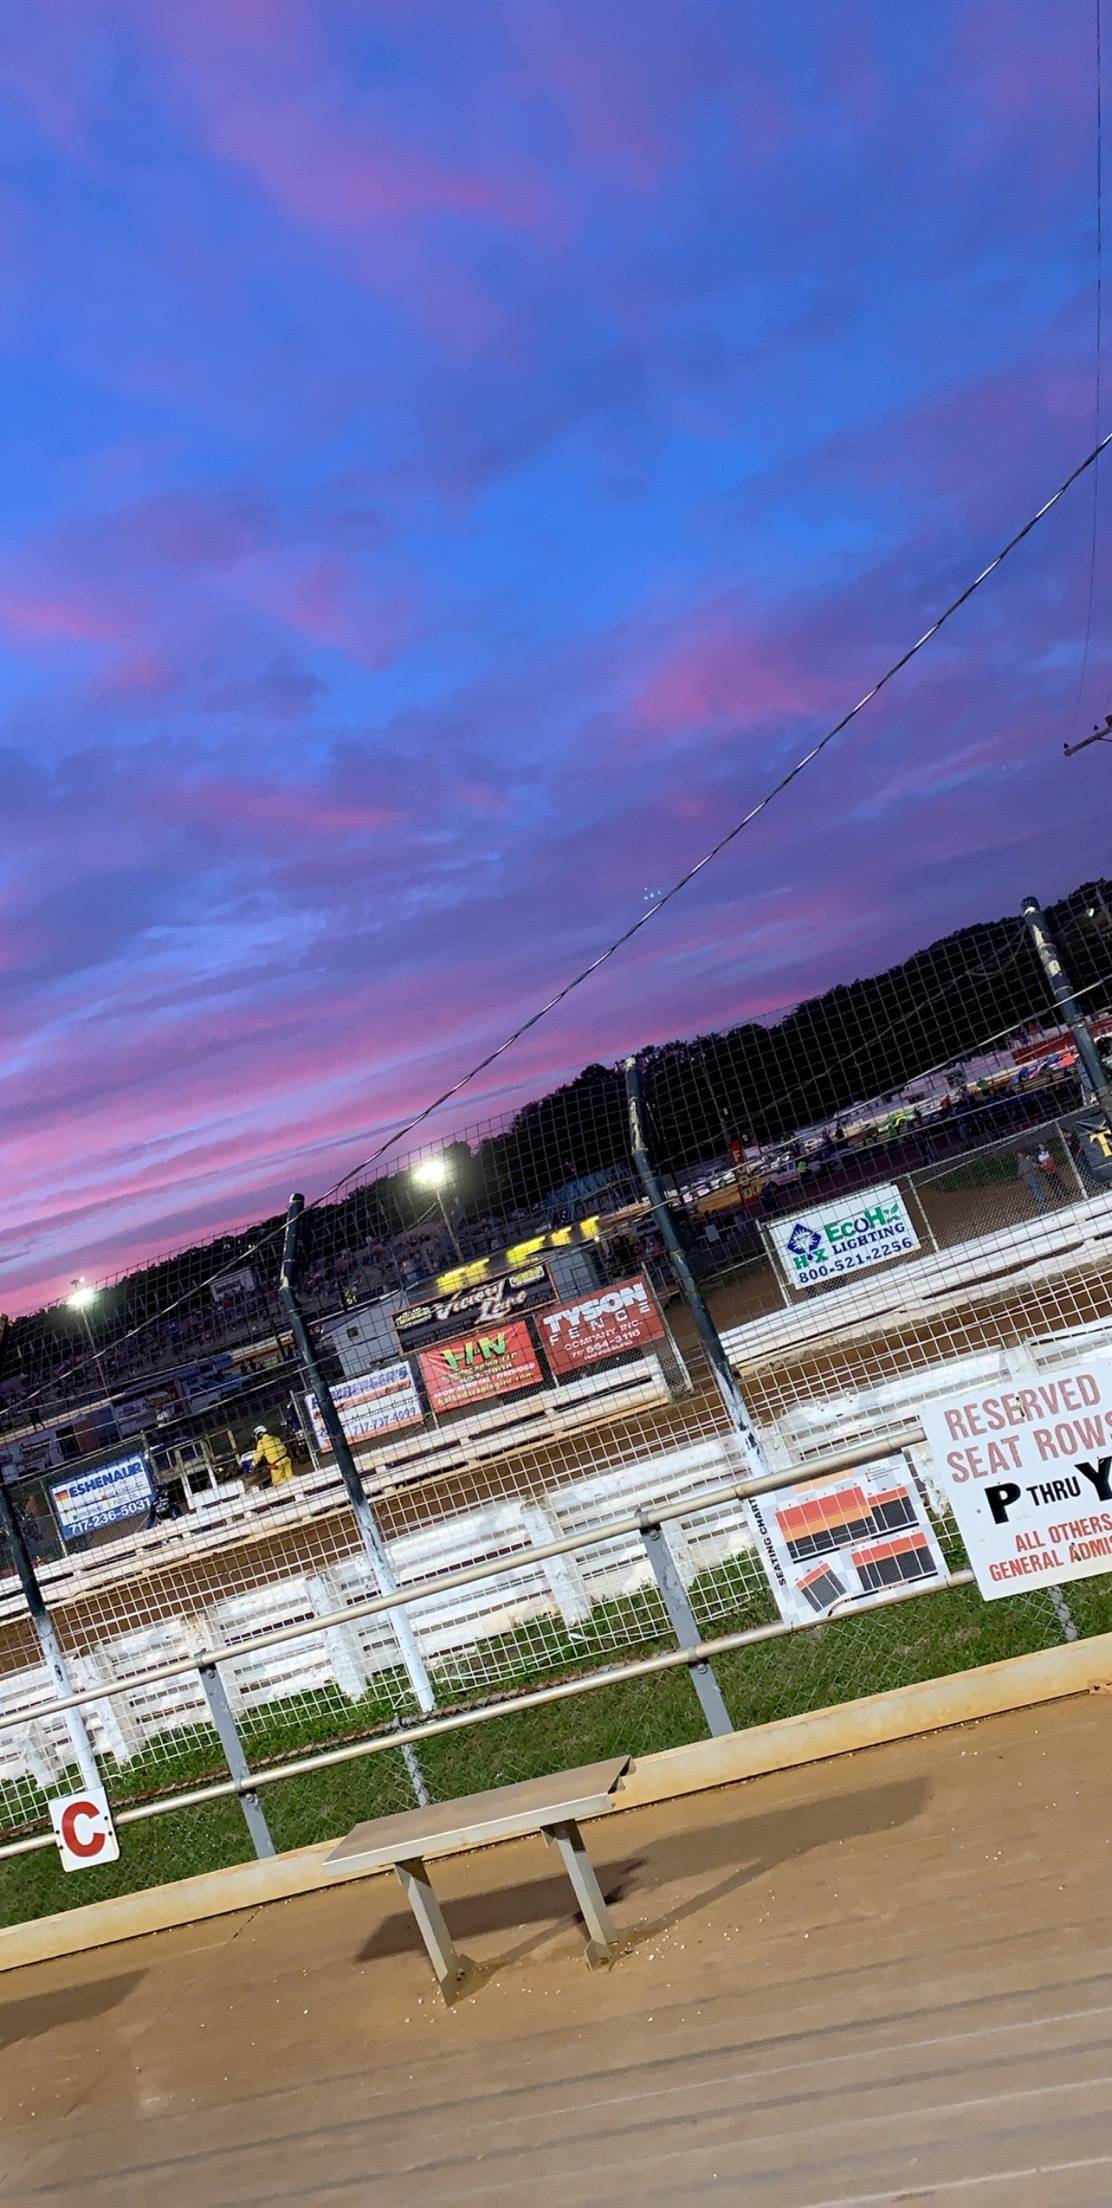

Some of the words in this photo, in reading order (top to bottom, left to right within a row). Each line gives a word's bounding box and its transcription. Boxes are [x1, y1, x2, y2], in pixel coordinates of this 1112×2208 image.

[799, 1237, 912, 1283] 800-521-2256
[832, 1222, 905, 1255] LIGHTING
[543, 1282, 647, 1334] TYSON
[549, 1301, 651, 1346] FENCE
[564, 1328, 616, 1351] COMPANY
[944, 1374, 1101, 1441] RESERVED
[946, 1435, 1023, 1483] SEAT
[984, 1483, 1021, 1525] P
[1026, 1476, 1081, 1506] THRU
[1074, 1456, 1112, 1502] Y
[69, 1498, 150, 1535] 717-236-5031
[748, 1499, 769, 1536] CHART
[1014, 1530, 1045, 1552] ALL
[1048, 1513, 1112, 1543] OTHERS
[763, 1538, 787, 1586] SEATING
[989, 1549, 1064, 1582] GENERAL
[62, 1801, 105, 1858] C
